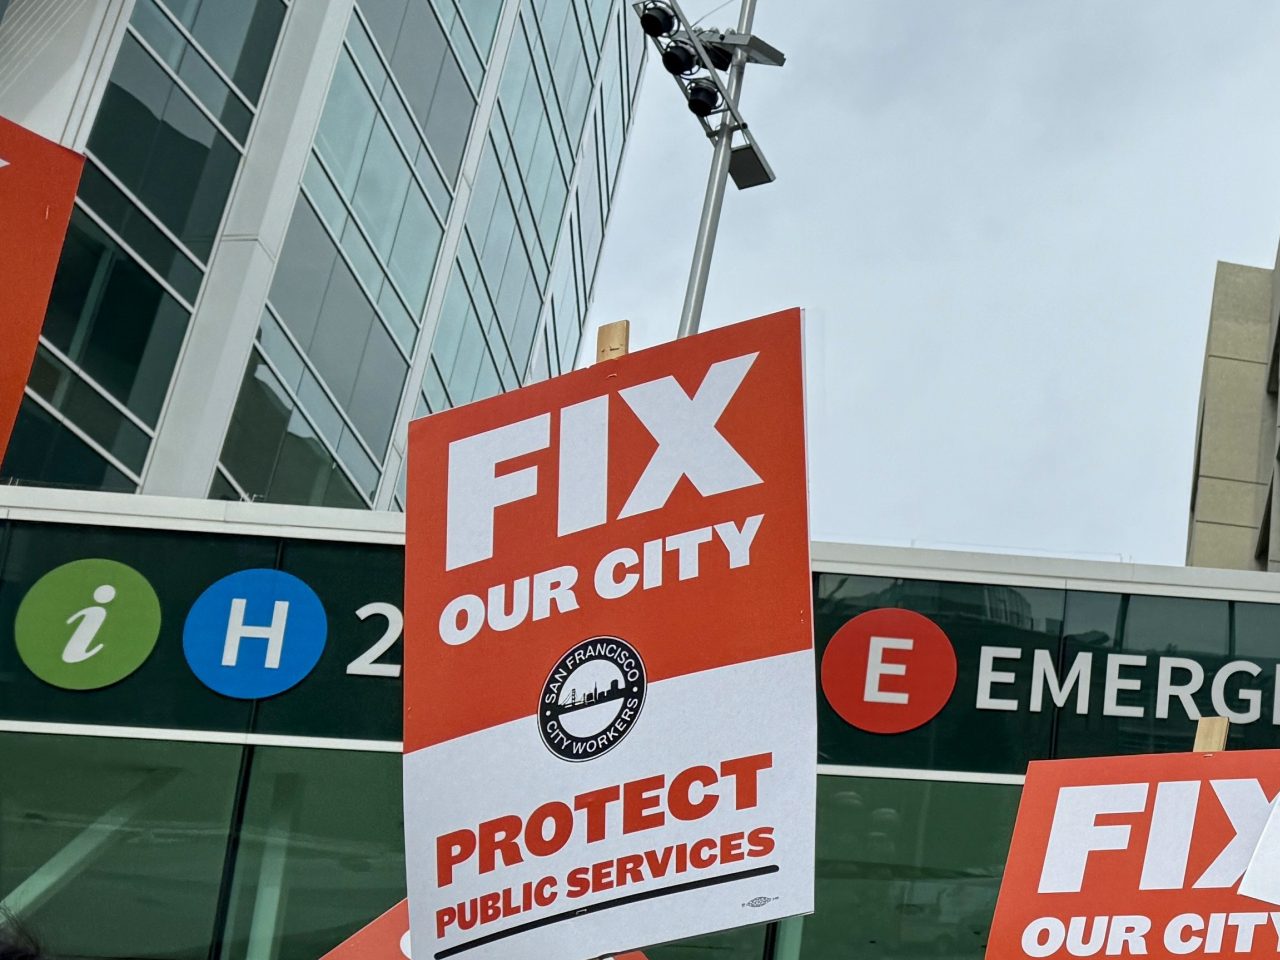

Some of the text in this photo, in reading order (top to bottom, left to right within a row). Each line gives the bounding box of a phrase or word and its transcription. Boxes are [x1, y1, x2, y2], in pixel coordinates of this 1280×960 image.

[446, 352, 764, 571] FIX
[439, 514, 764, 645] OUR CITY
[221, 598, 289, 669] H
[346, 602, 403, 677] 2
[546, 643, 639, 704] SAN FRANCISCO
[863, 636, 913, 704] E
[546, 698, 639, 754] CITY WORKERS
[437, 752, 772, 888] PROTECT
[437, 876, 557, 939] PUBLIC
[566, 827, 774, 899] SERVICES
[1021, 915, 1151, 958] OUR
